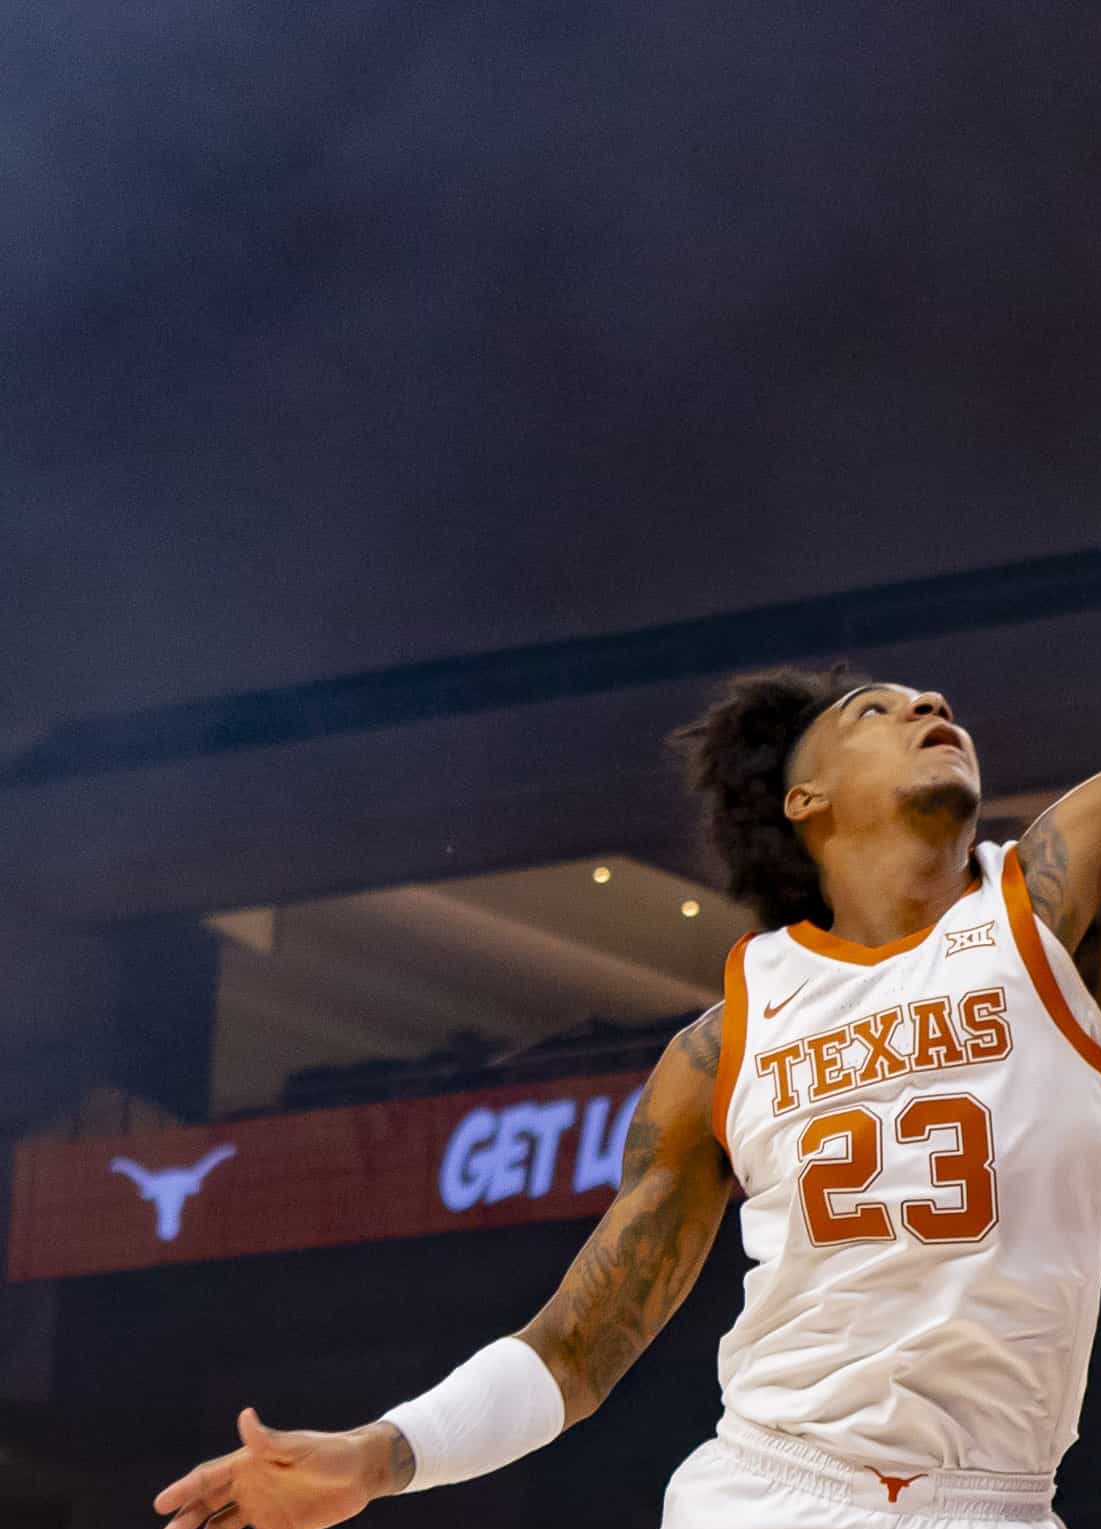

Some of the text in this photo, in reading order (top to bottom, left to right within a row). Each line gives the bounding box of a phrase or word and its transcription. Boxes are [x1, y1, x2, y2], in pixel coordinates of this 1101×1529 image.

[755, 987, 1012, 1117] TEXAS
[439, 1099, 576, 1212] GET
[797, 1092, 999, 1247] 23
